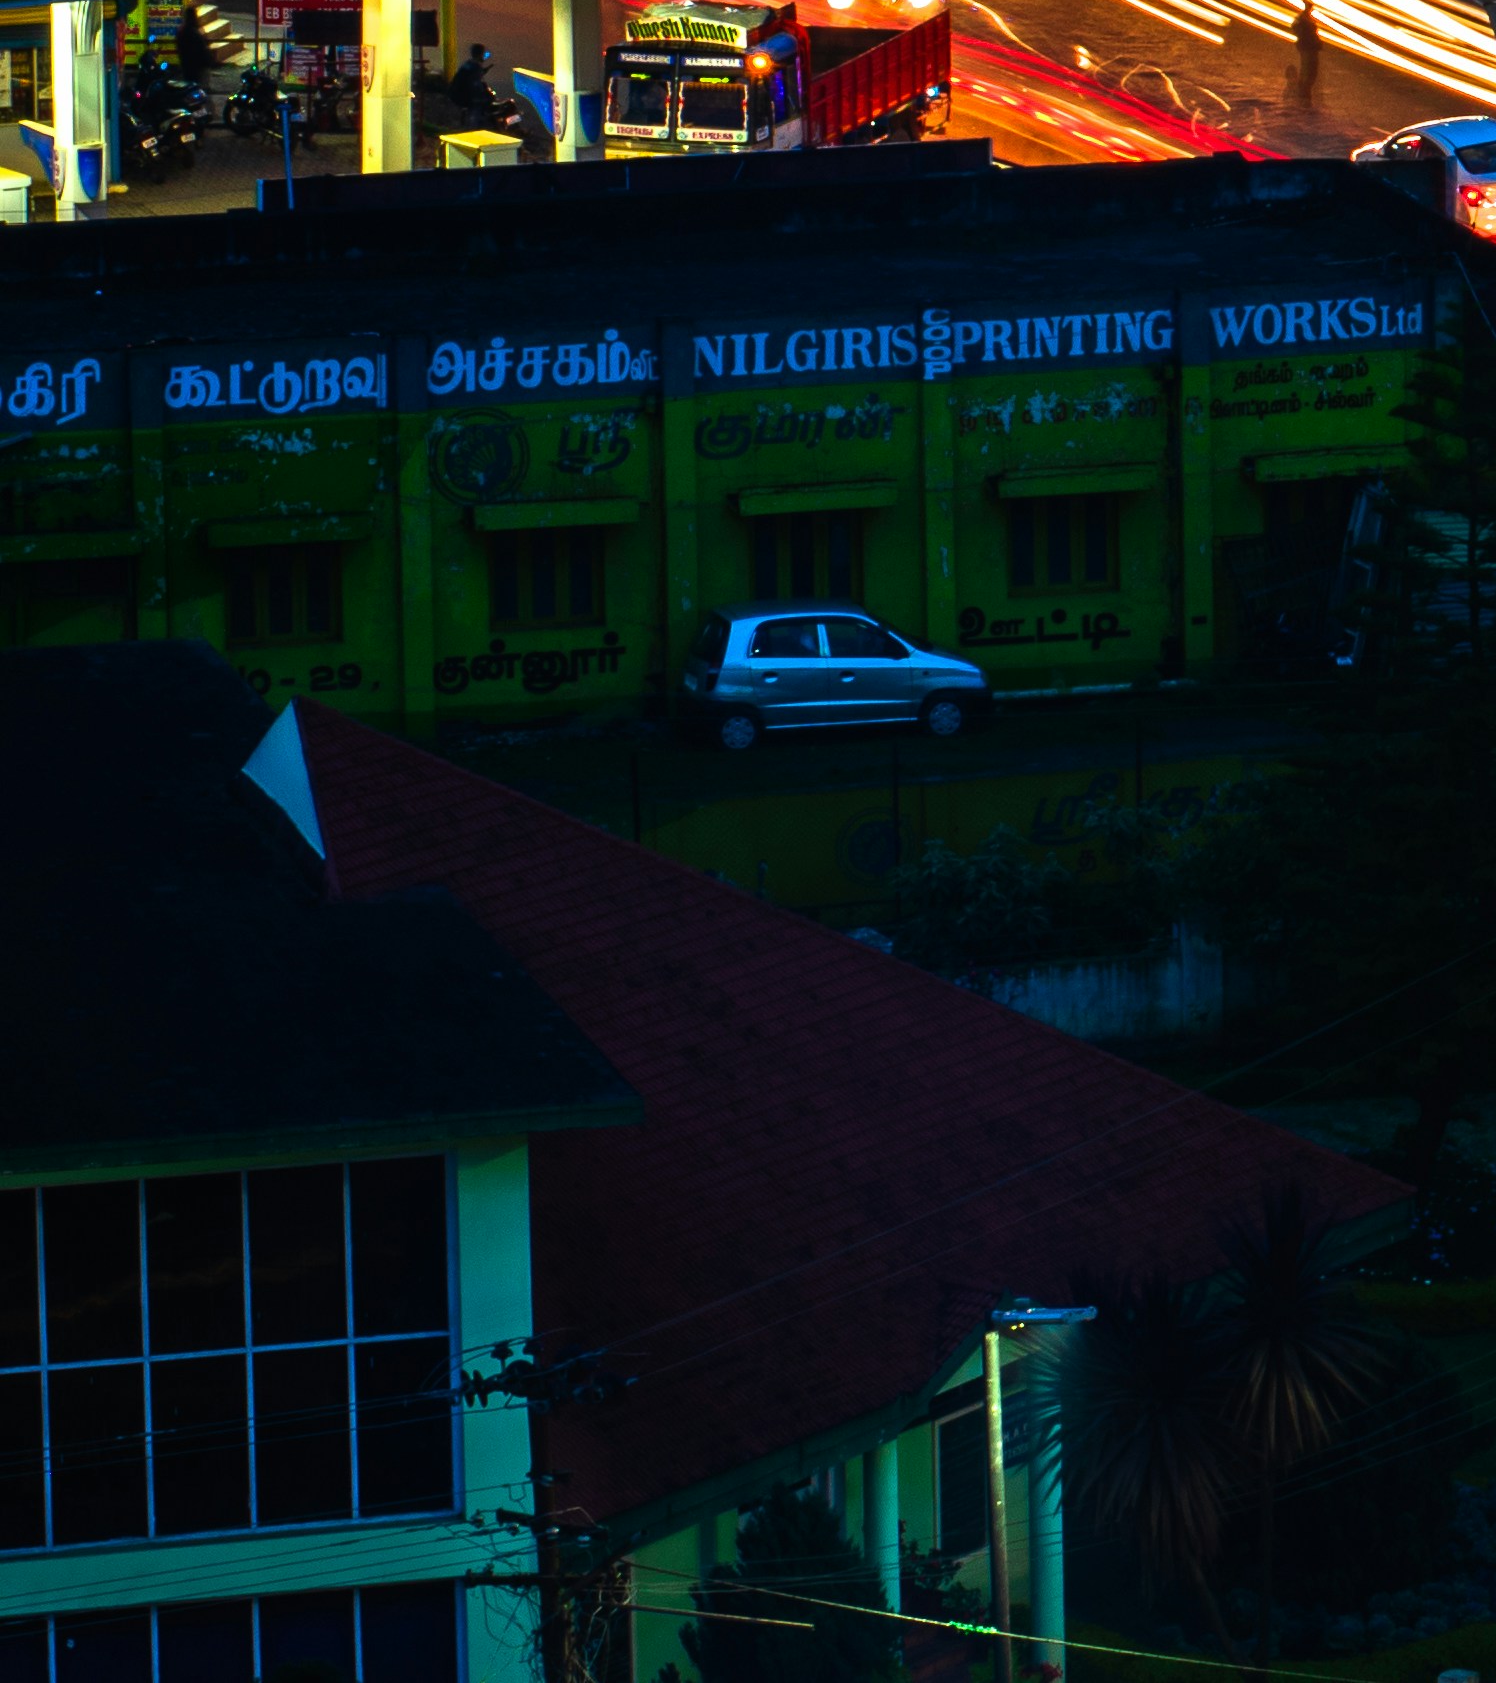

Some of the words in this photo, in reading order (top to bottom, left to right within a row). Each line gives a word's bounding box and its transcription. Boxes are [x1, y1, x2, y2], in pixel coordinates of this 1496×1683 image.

[692, 131, 734, 141] EXPRESS
[692, 322, 919, 379] NILGIRIS
[952, 309, 1174, 364] PRINTING
[1208, 296, 1377, 348] WORKS
[1379, 301, 1424, 337] Ltd
[163, 352, 389, 415] கூட்டுறவு
[427, 328, 634, 396] அச்சகம்
[956, 605, 1132, 651] ஊட்டி
[431, 631, 627, 695] குன்னூர்
